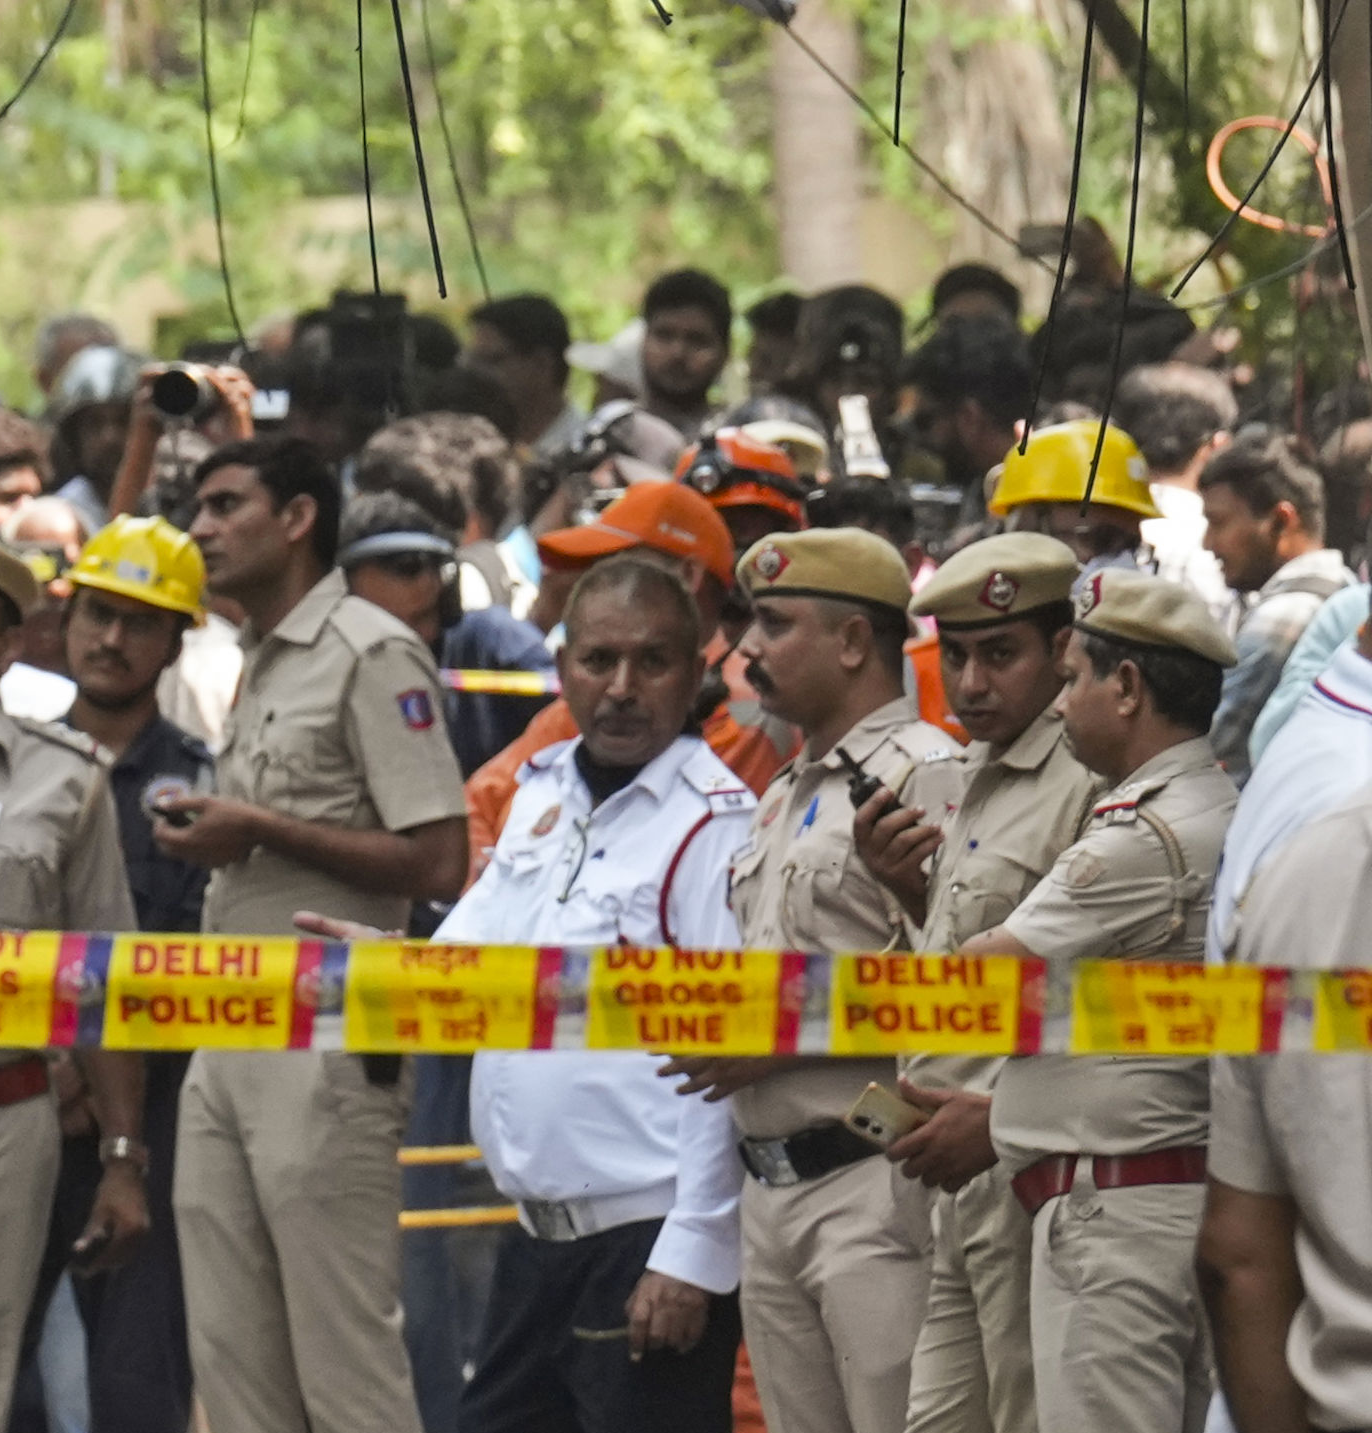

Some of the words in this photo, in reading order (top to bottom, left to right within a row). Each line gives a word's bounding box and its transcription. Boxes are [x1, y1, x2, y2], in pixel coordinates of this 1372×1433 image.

[133, 943, 261, 977] DELHI
[854, 956, 985, 986] DELHI
[614, 982, 745, 1007] CROSS
[119, 995, 277, 1026] POLICE
[845, 1003, 1004, 1034] POLICE
[638, 1014, 725, 1044] LINE
